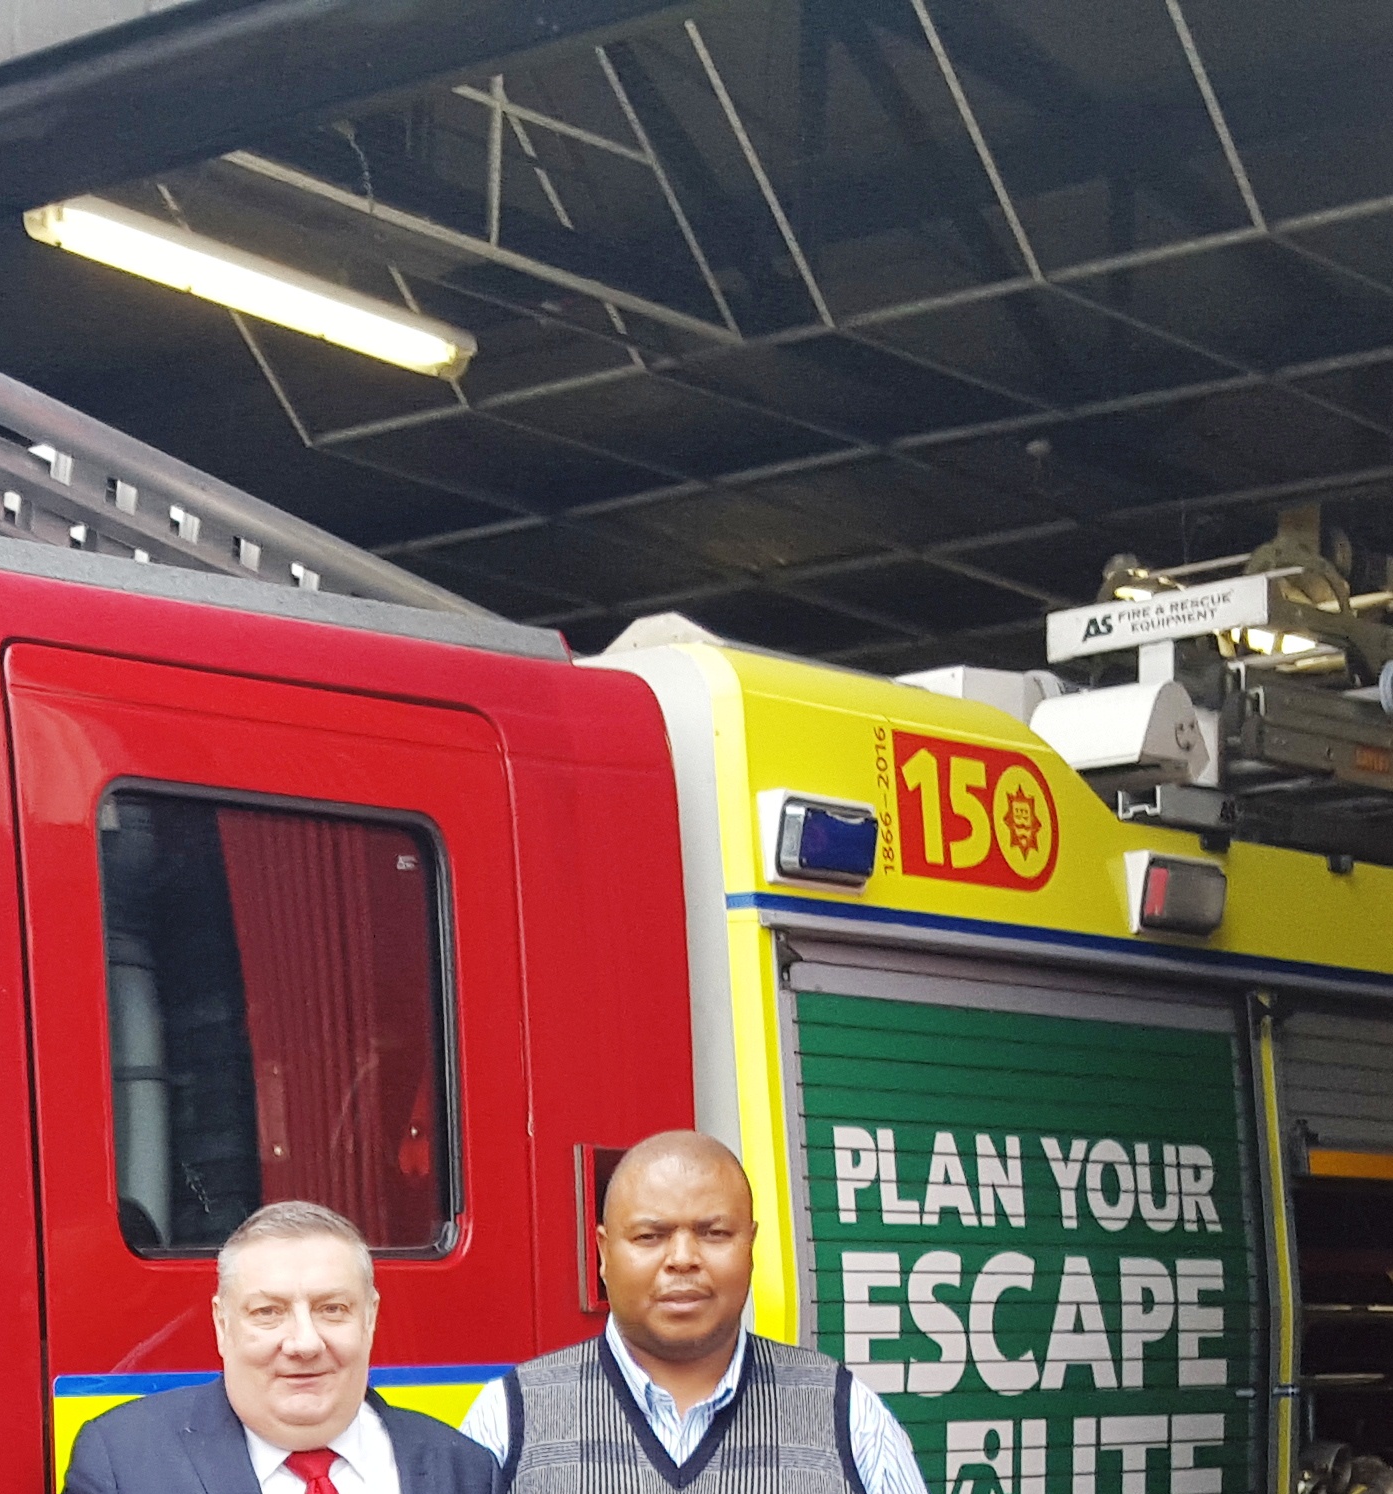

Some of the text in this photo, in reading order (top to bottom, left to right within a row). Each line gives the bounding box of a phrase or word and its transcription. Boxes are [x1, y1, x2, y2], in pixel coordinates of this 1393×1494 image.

[1118, 605, 1152, 624] FIRE
[1130, 609, 1216, 633] EQUIPMENT
[832, 1126, 1223, 1233] PLAN YOUR
[841, 1250, 1228, 1397] ESCAPE
